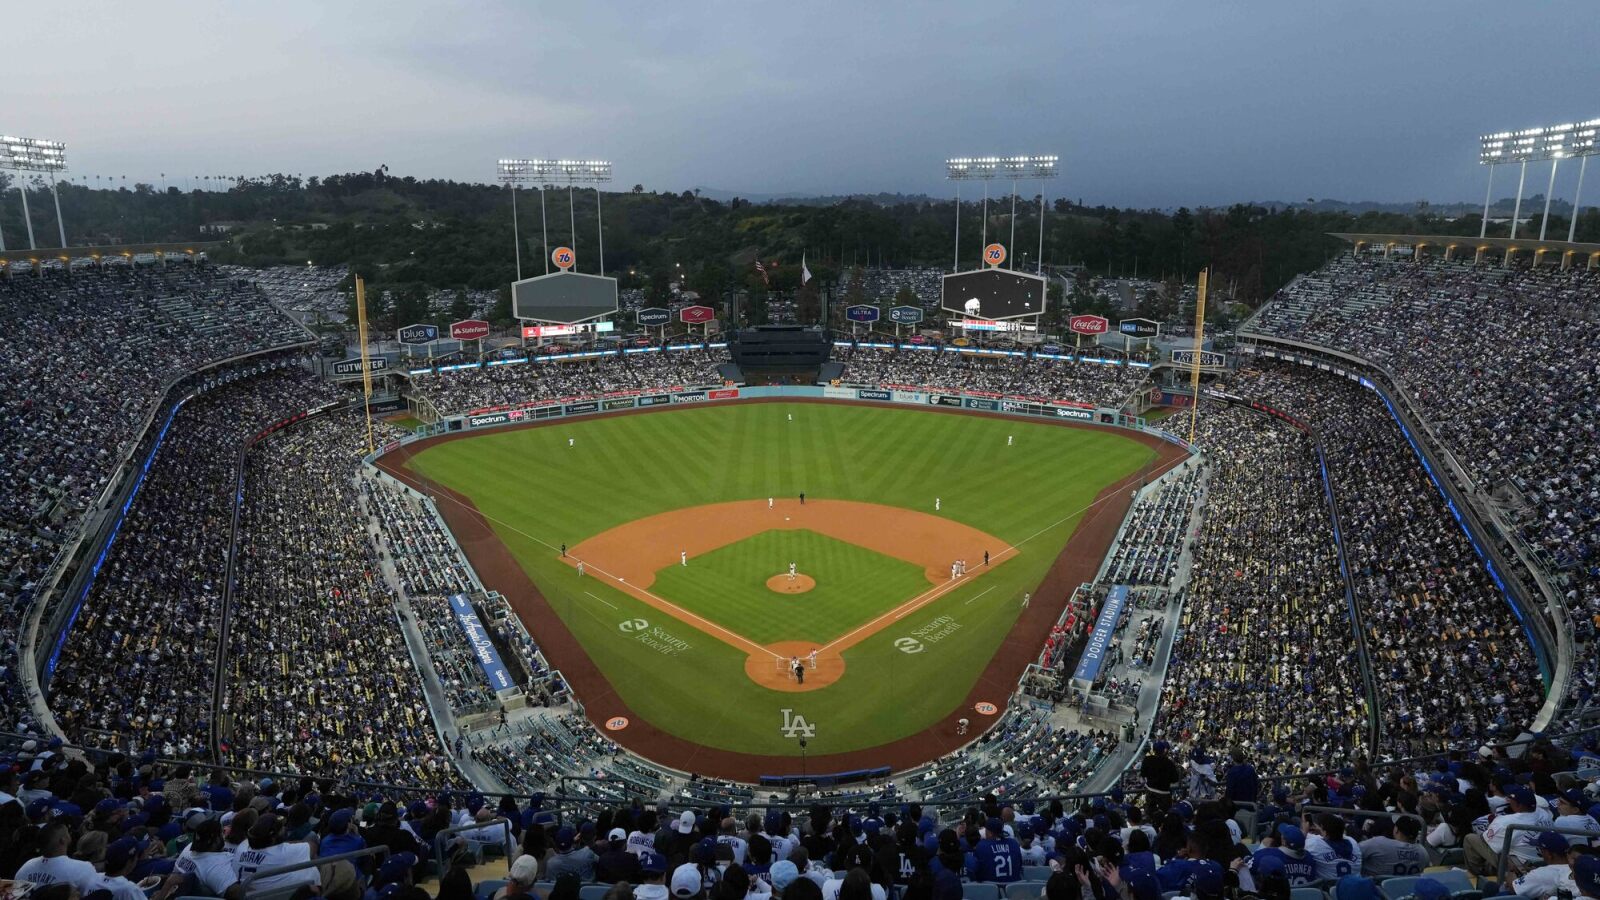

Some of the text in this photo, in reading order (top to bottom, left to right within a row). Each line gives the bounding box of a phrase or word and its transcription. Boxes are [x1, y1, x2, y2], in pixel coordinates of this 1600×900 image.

[559, 253, 570, 263] 76
[989, 250, 1000, 259] 76
[640, 313, 666, 321] Spectrum
[403, 329, 425, 339] blue
[337, 360, 384, 373] CUTWTER
[678, 394, 705, 403] MORTON
[860, 390, 887, 399] Spectrum
[1057, 408, 1089, 418] Spectrum
[471, 414, 505, 426] Spectrum
[911, 614, 954, 638] Security
[1087, 628, 1108, 659] DODGER
[1100, 599, 1121, 627] STADIUM
[650, 626, 689, 651] Security
[924, 622, 963, 643] Benefit
[635, 632, 675, 655] Benefit
[980, 704, 993, 712] 76
[611, 719, 625, 728] 76
[780, 708, 816, 738] LA
[629, 834, 655, 849] ROBINSO
[991, 843, 1010, 854] LUNA
[899, 852, 915, 878] LA
[994, 855, 1013, 878] 21
[1284, 864, 1312, 876] TURNER
[27, 872, 57, 884] BRYANT
